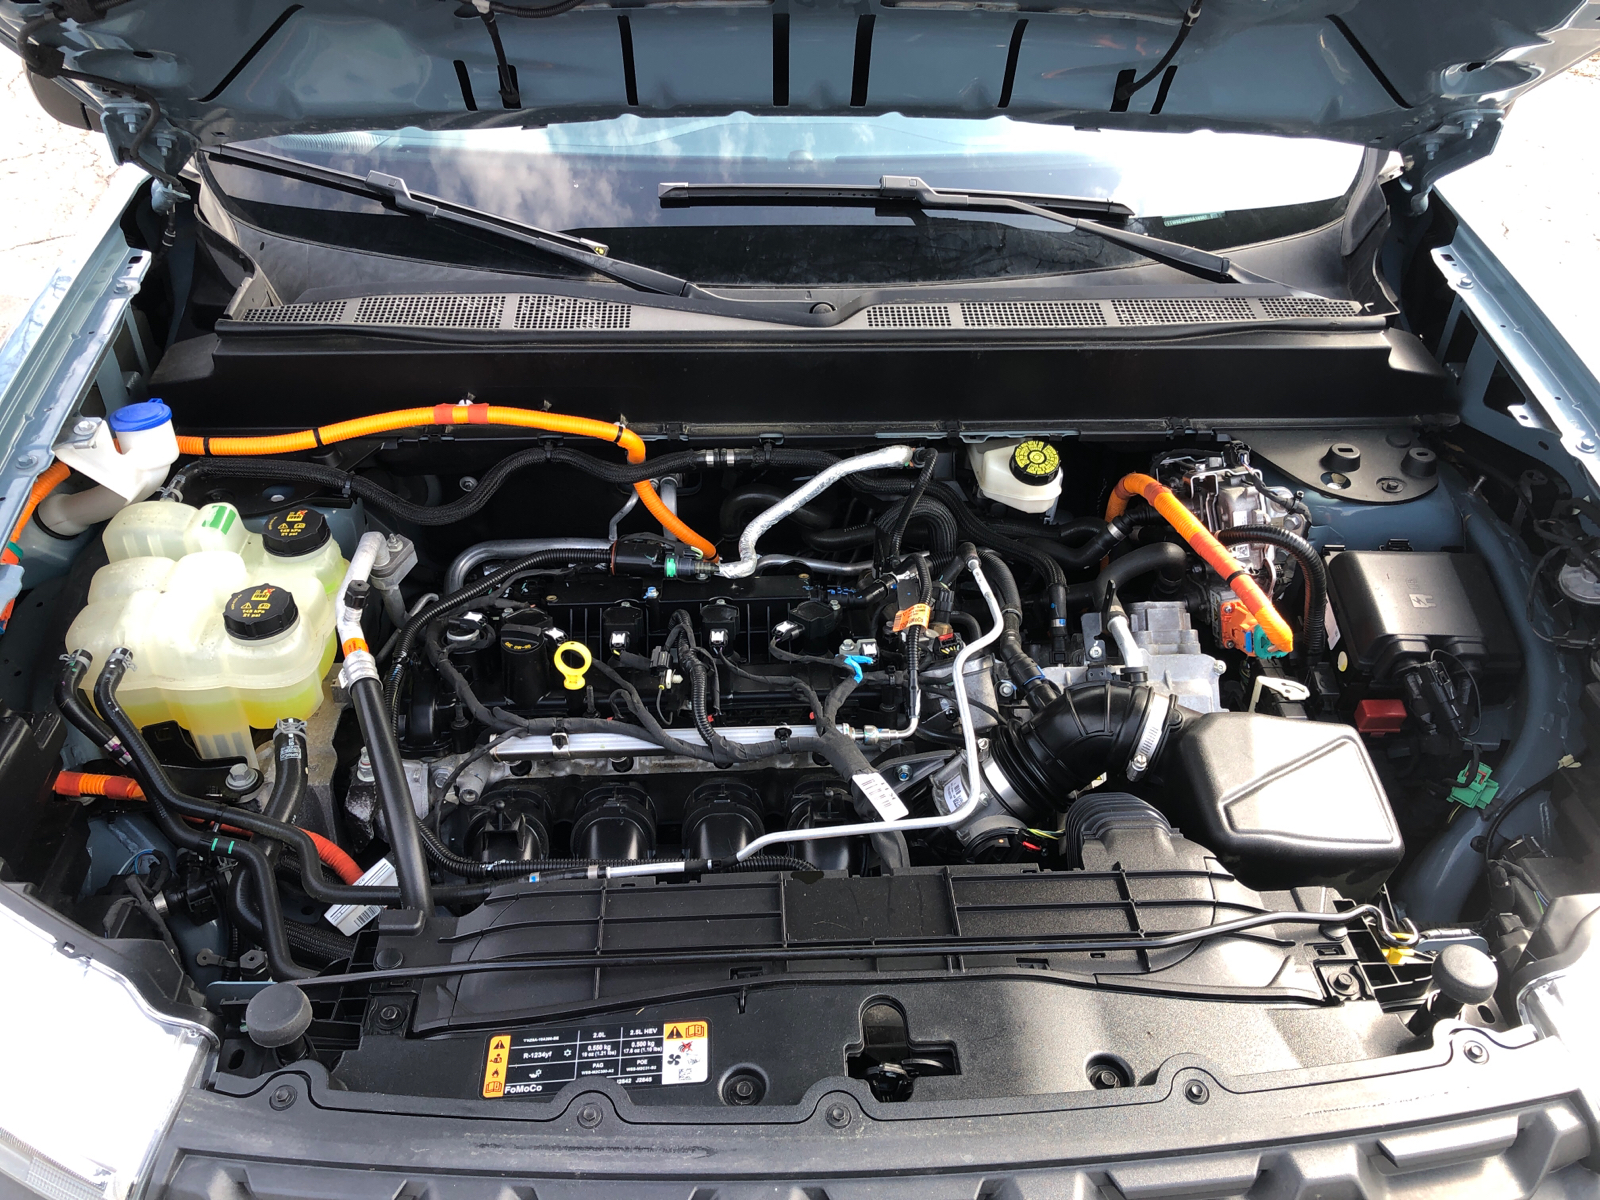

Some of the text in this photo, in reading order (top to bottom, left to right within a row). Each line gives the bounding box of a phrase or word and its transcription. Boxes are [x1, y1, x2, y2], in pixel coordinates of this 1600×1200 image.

[603, 1043, 612, 1051] kg
[647, 1040, 655, 1048] kg
[523, 1051, 553, 1059] R-1234yf
[504, 1084, 543, 1094] FoMoCo
